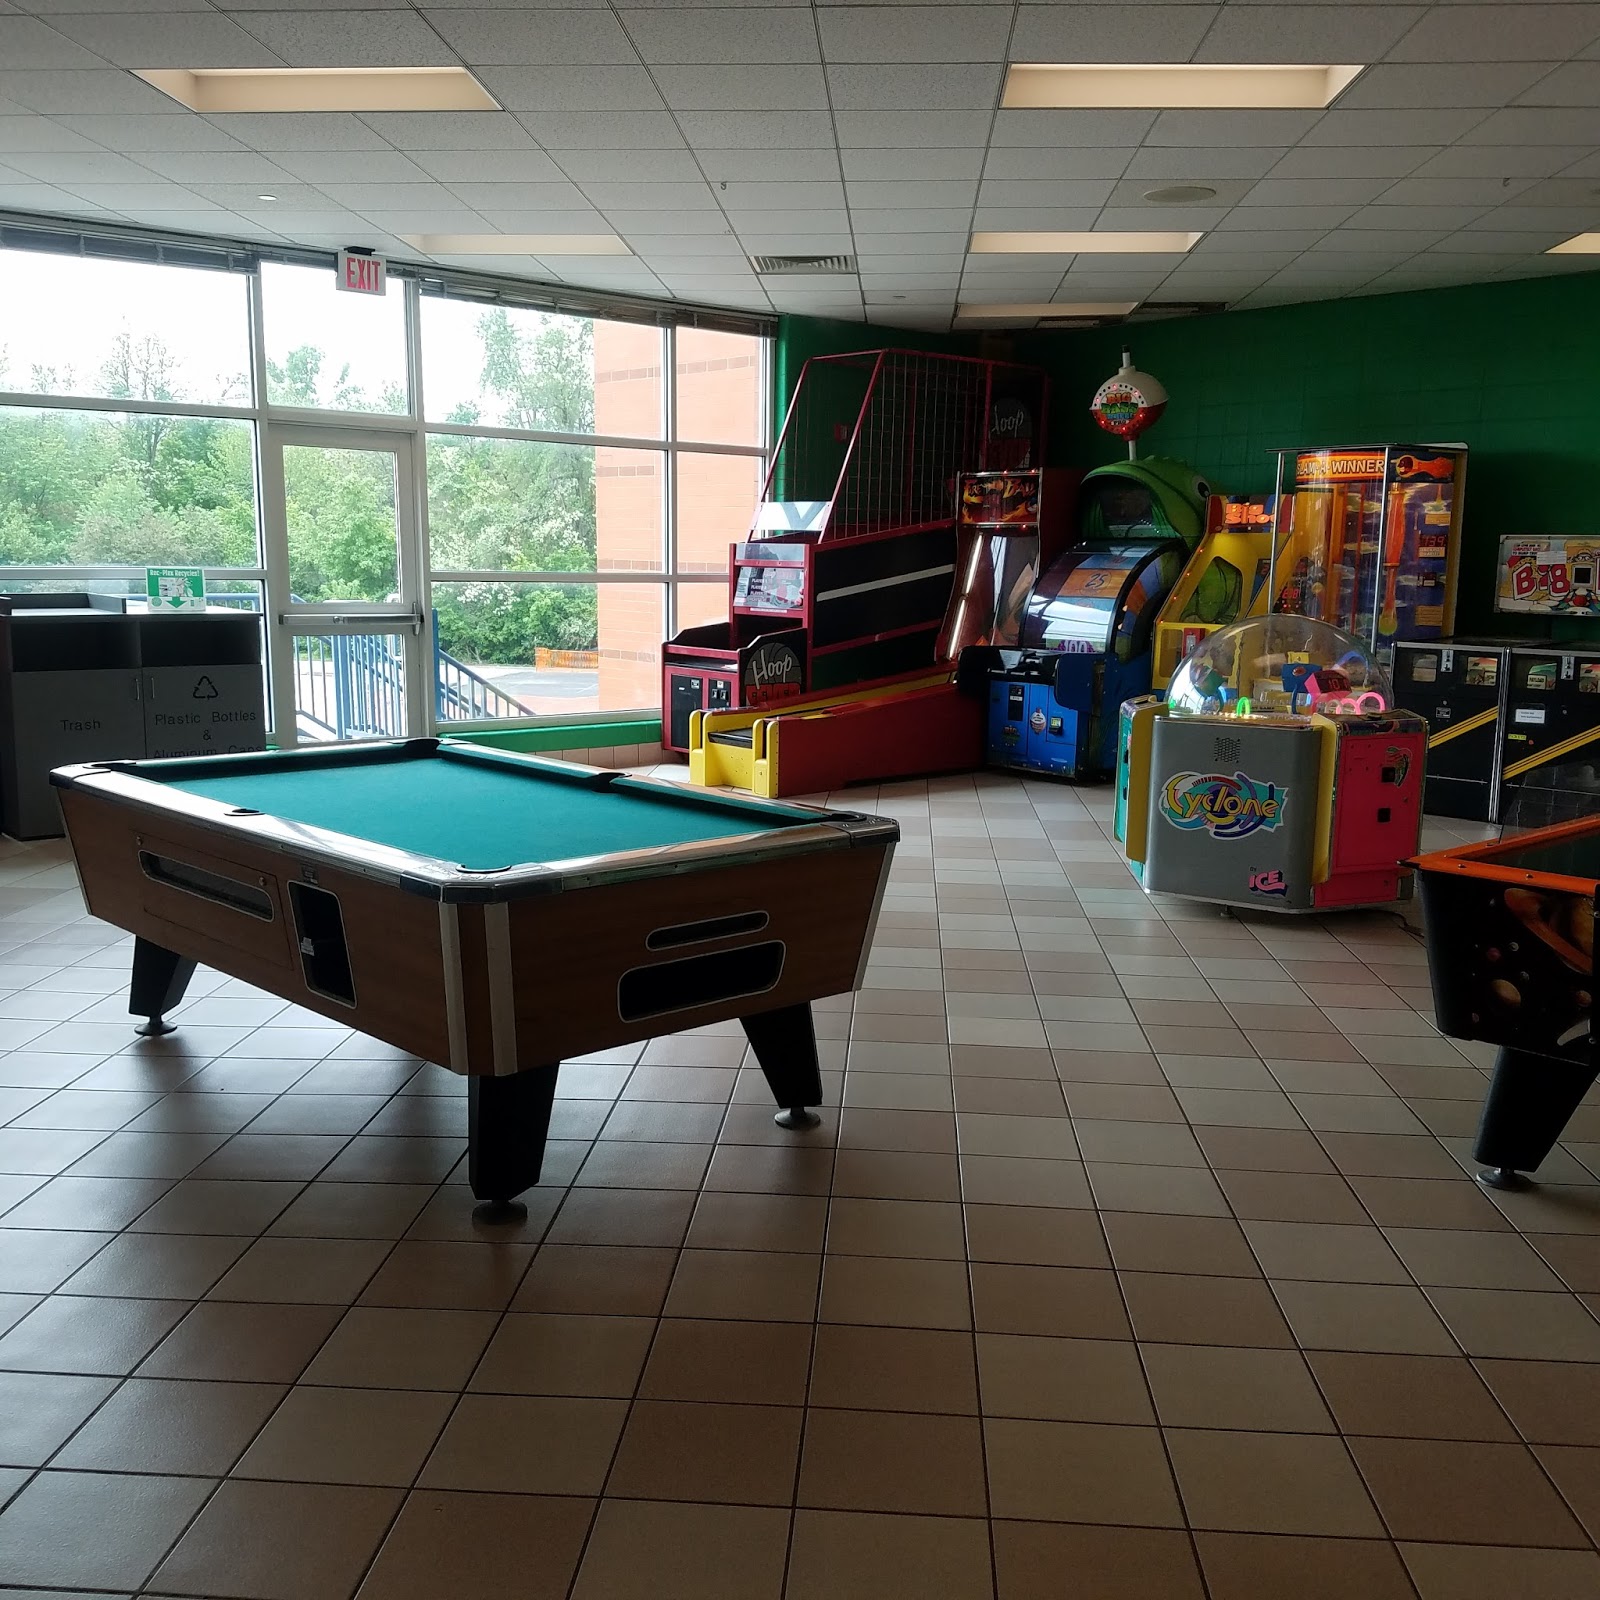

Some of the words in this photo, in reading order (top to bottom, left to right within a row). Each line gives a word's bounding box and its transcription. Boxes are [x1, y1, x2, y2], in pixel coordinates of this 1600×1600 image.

[346, 257, 381, 292] EXIT
[1101, 402, 1138, 414] BASS
[1085, 573, 1109, 589] 25
[752, 649, 793, 690] Hoop
[60, 718, 101, 731] Trash
[155, 713, 201, 725] Plastic
[211, 711, 256, 723] Bottles
[202, 729, 212, 741] &
[1166, 773, 1280, 819] Cyclone
[1248, 869, 1287, 895] ICE
